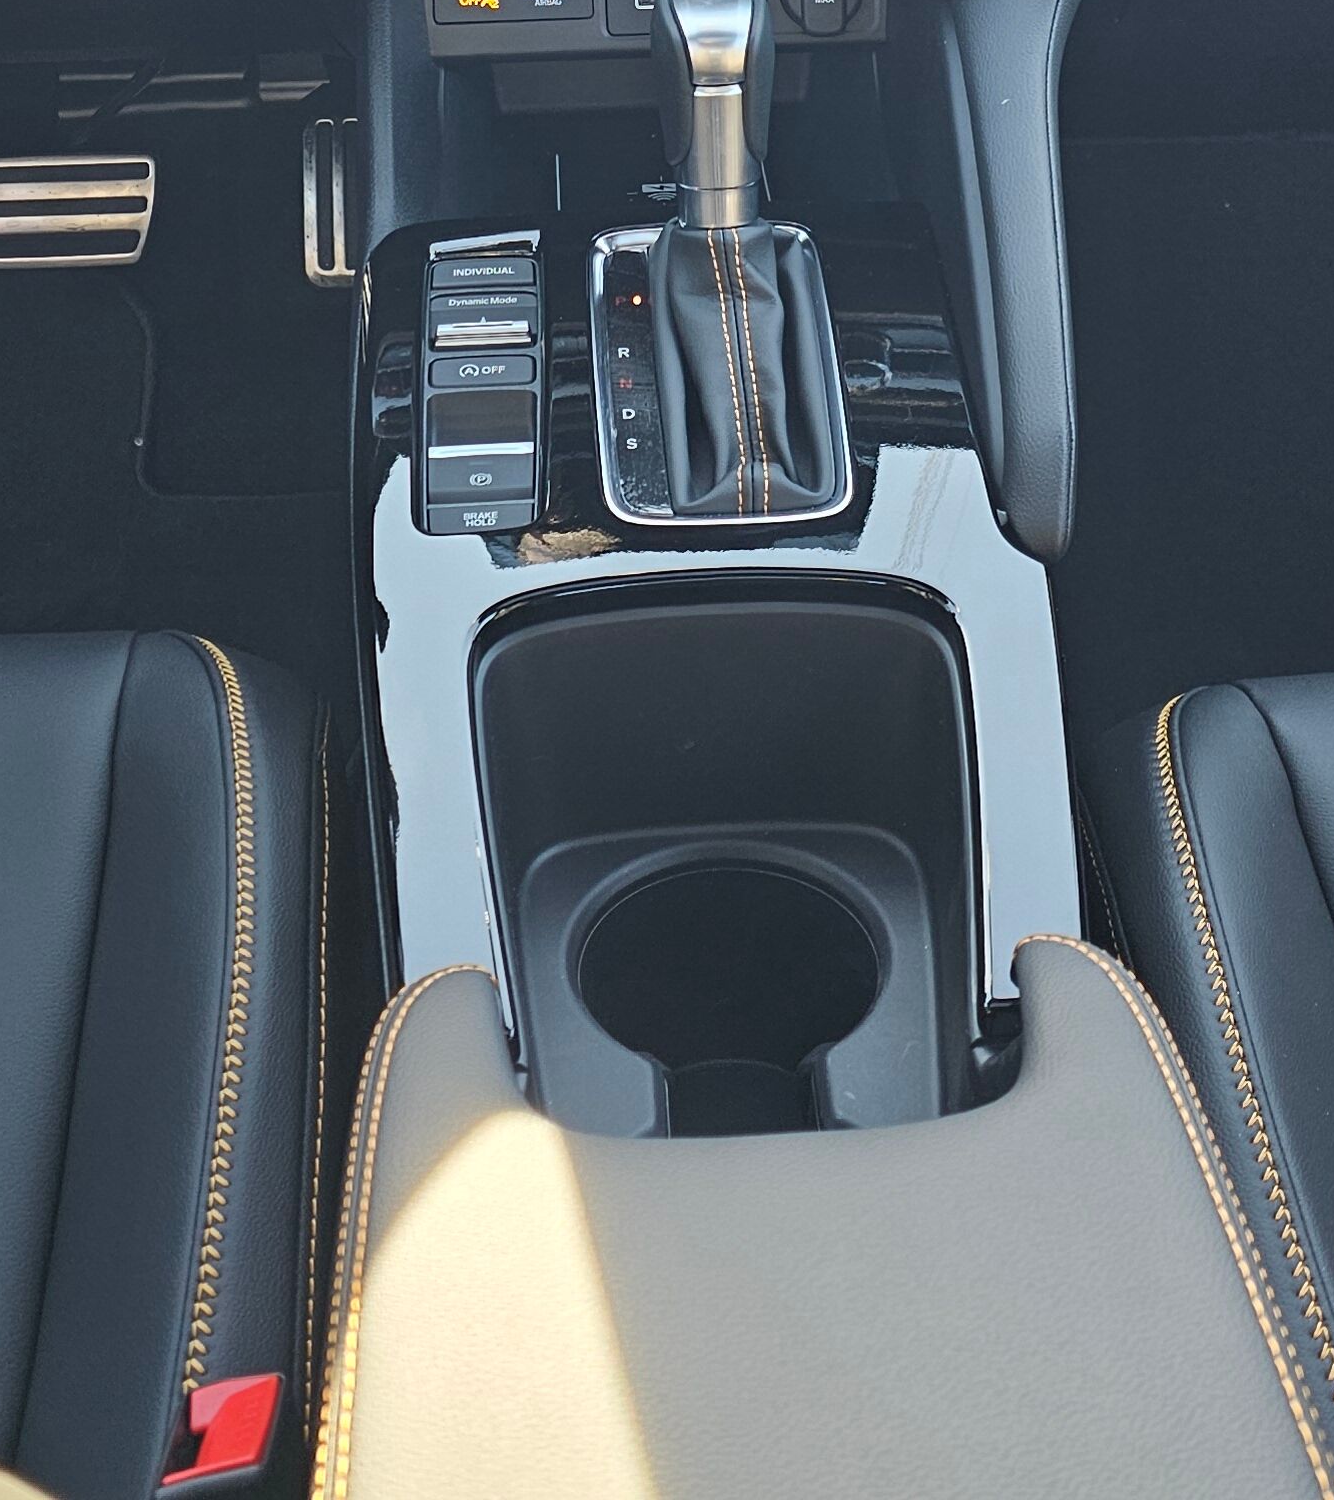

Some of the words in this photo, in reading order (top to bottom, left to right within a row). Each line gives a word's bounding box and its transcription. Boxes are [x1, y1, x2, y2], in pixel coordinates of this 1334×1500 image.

[453, 267, 515, 277] INDIVIDUAL
[448, 297, 489, 307] Dynamic
[490, 296, 517, 304] Mode
[618, 347, 630, 358] R
[482, 366, 505, 375] OFF
[619, 378, 632, 388] N
[622, 408, 636, 420] D
[627, 438, 638, 450] S
[463, 511, 498, 520] BRAKE
[465, 519, 496, 527] HOLD
